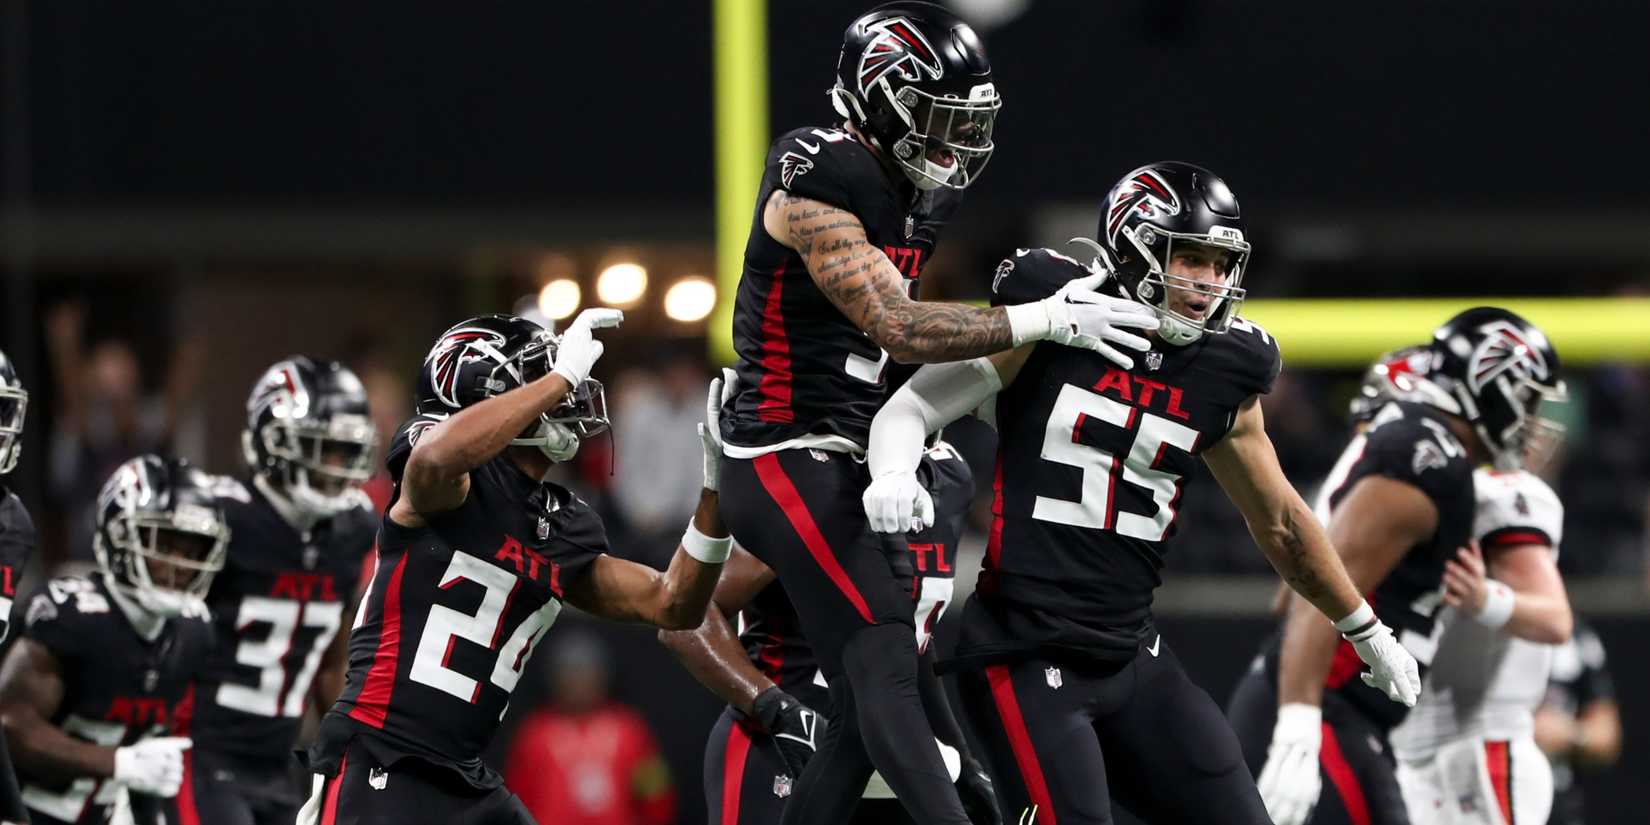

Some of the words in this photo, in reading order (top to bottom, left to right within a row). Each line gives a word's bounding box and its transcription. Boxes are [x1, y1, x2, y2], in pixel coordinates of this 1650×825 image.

[1221, 230, 1239, 240] ATL
[1092, 368, 1191, 420] ATL
[1032, 383, 1200, 542] 55
[495, 534, 564, 598] ATL
[907, 543, 951, 573] TL
[271, 574, 336, 600] ATL
[410, 550, 562, 704] 24
[216, 599, 344, 718] 37
[104, 698, 166, 726] ATL
